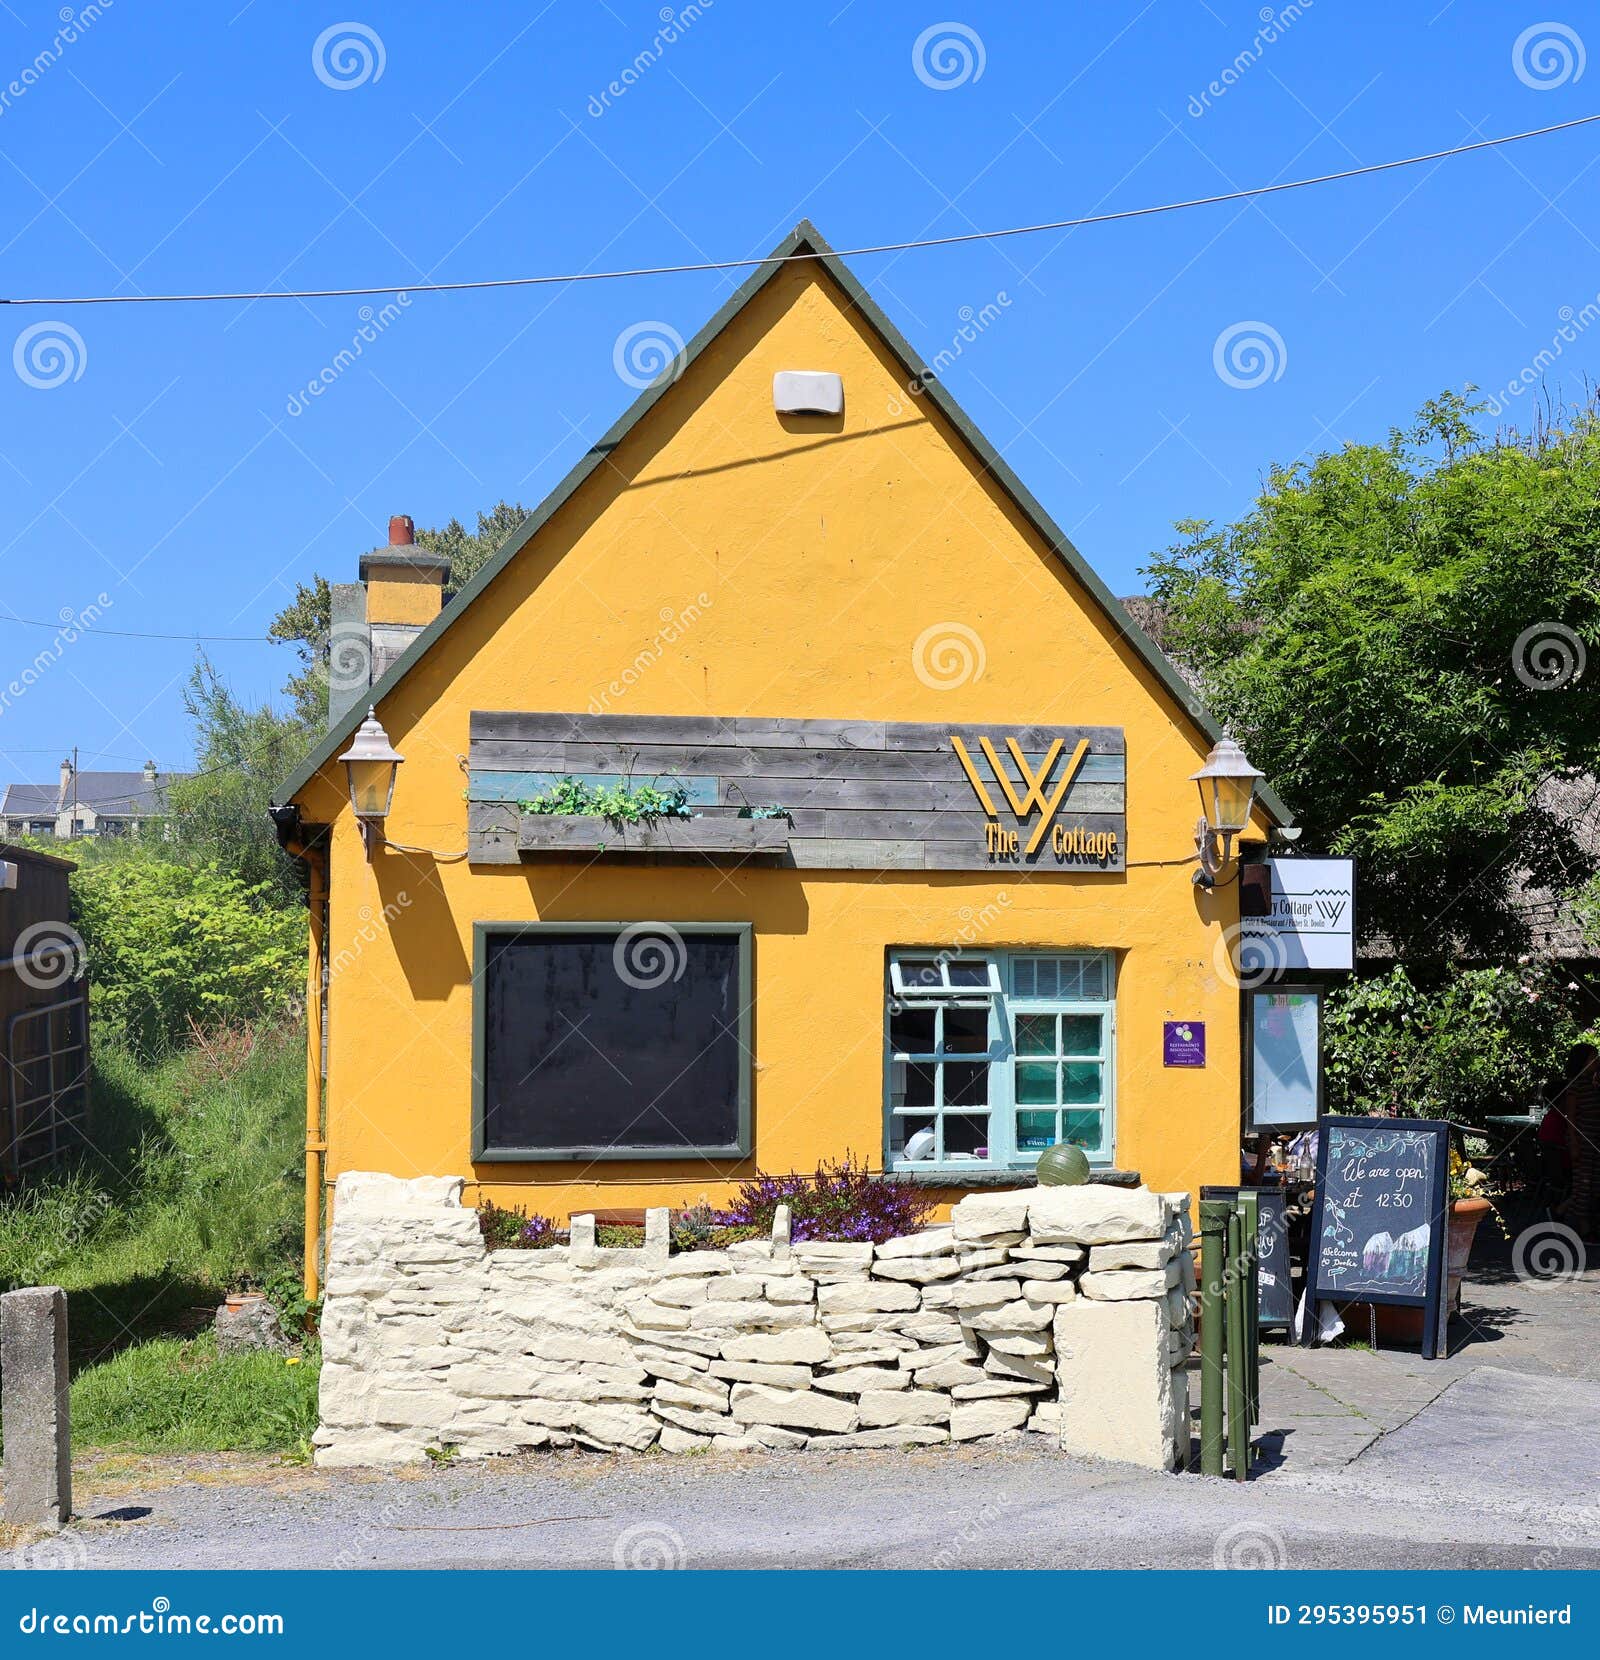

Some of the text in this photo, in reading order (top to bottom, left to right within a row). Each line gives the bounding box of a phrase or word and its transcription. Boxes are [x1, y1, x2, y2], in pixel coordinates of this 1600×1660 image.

[985, 822, 1018, 854] The
[1052, 824, 1117, 859] Cottage
[1280, 899, 1313, 918] Cottage
[1341, 1157, 1425, 1192] We are open
[1343, 1186, 1363, 1208] at
